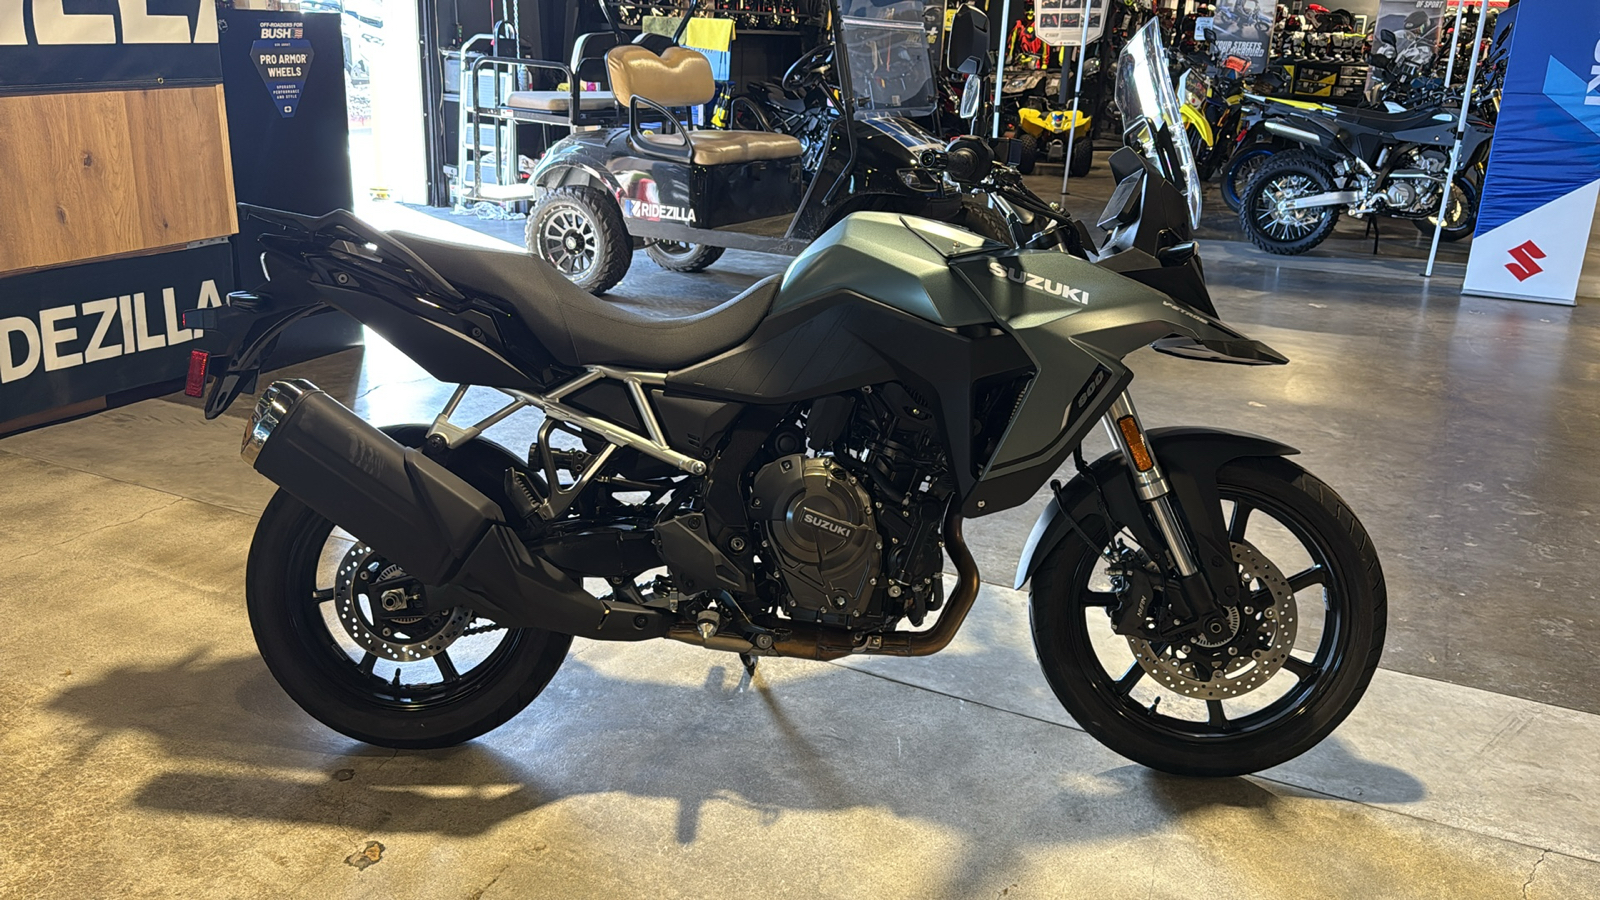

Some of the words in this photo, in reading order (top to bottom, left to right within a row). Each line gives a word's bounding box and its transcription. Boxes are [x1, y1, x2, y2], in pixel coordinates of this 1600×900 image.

[1424, 0, 1444, 8] SPORT
[261, 28, 291, 39] BUSH
[1233, 40, 1262, 50] STREETS
[260, 54, 277, 65] PRO
[279, 53, 307, 64] ARMOR
[268, 66, 302, 78] WHEELS
[641, 202, 696, 223] RIDEZILLA
[988, 261, 1090, 305] SUZUKI
[1078, 370, 1104, 408] 800
[803, 514, 851, 537] SUZUKI
